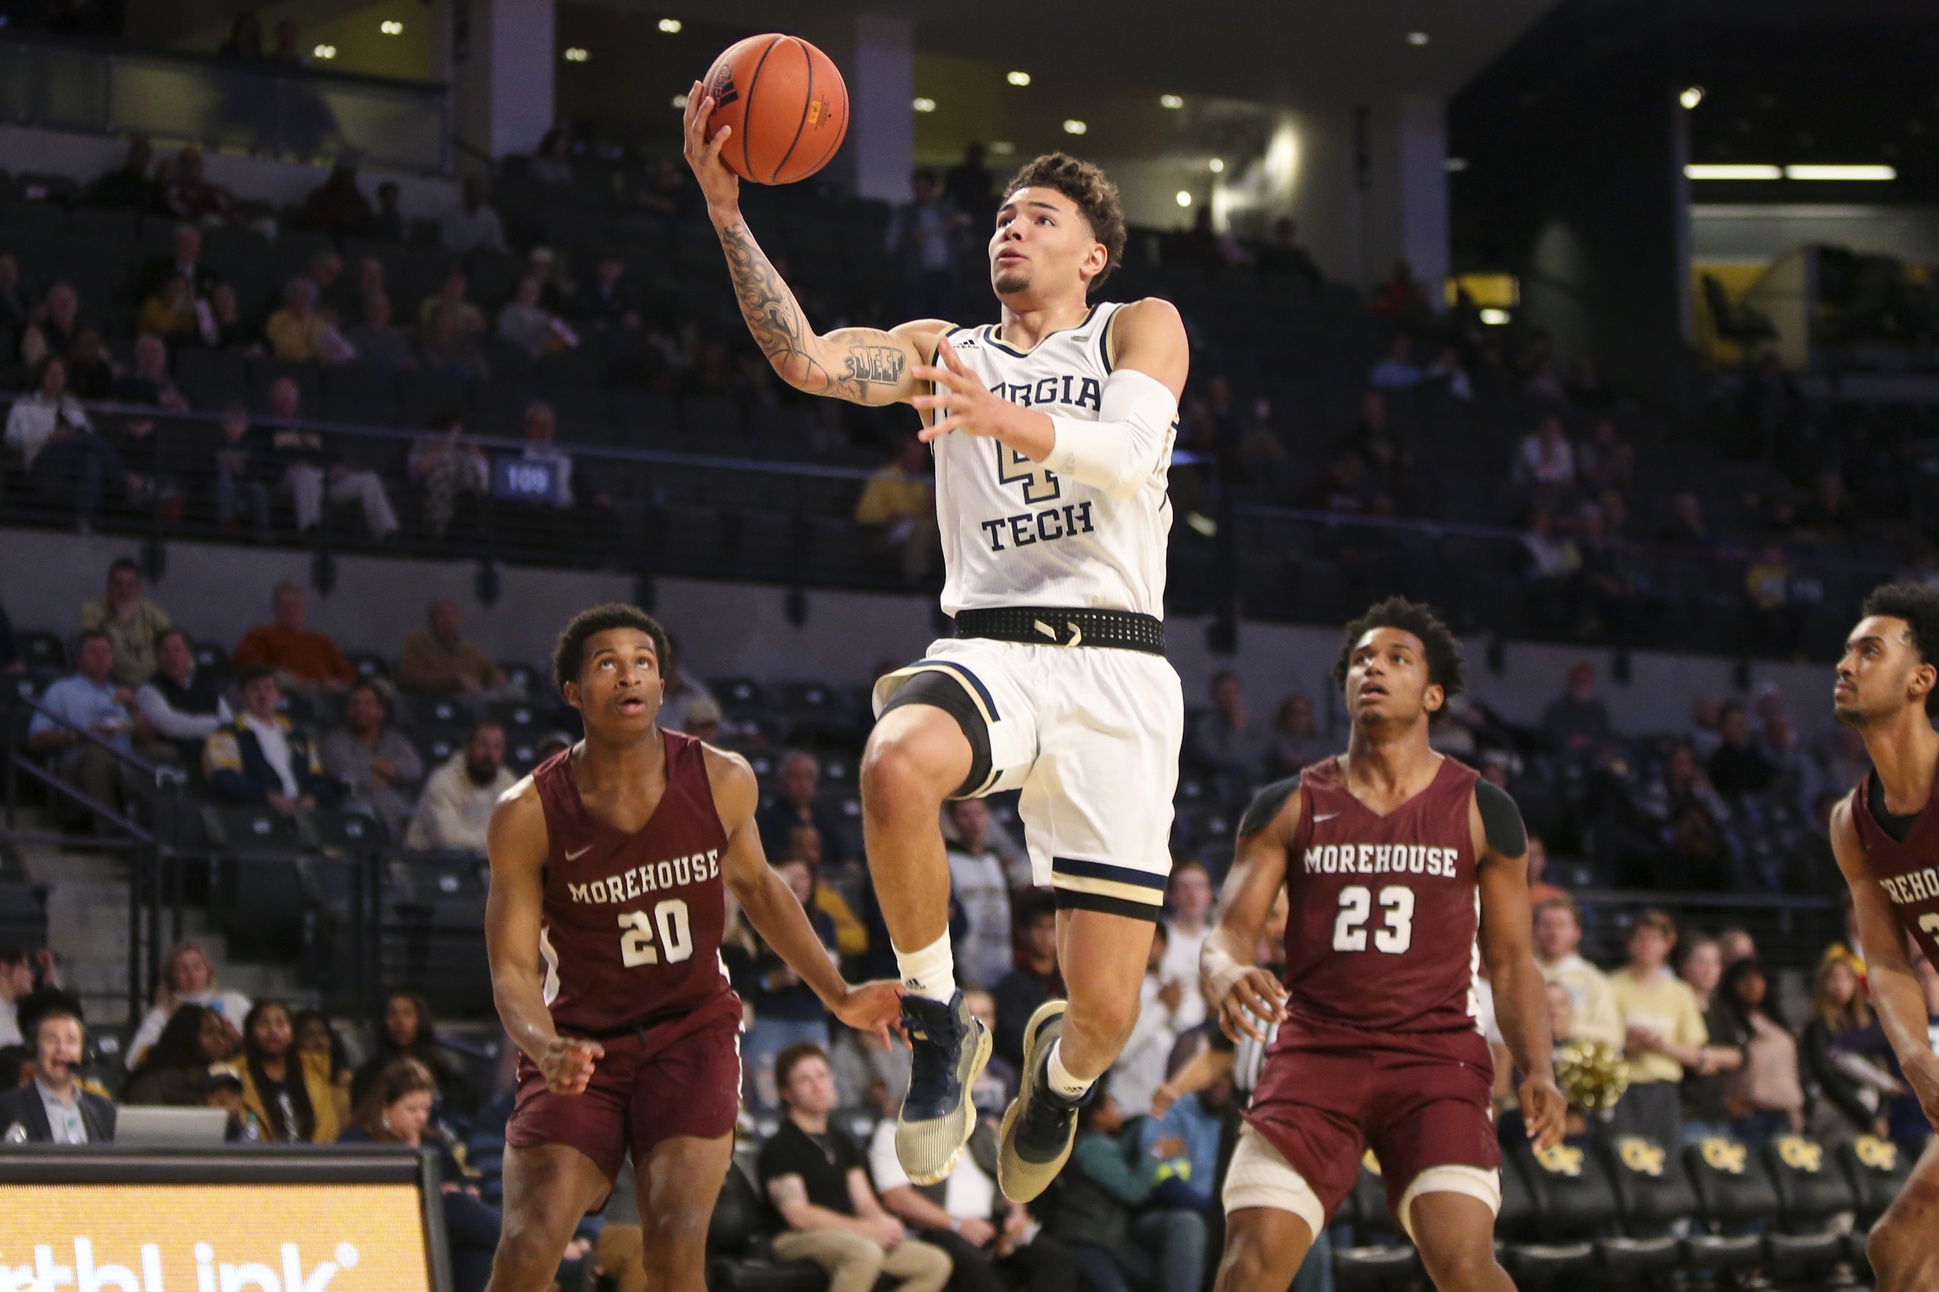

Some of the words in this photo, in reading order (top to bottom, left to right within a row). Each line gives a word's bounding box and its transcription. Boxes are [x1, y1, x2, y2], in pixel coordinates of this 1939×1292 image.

[982, 501, 1094, 551] TECH
[567, 848, 719, 904] MOREHOUSE
[1303, 844, 1459, 879] MOREHOUSE
[617, 898, 693, 968] 20
[1332, 885, 1415, 954] 23
[0, 1236, 341, 1292] rthLink
